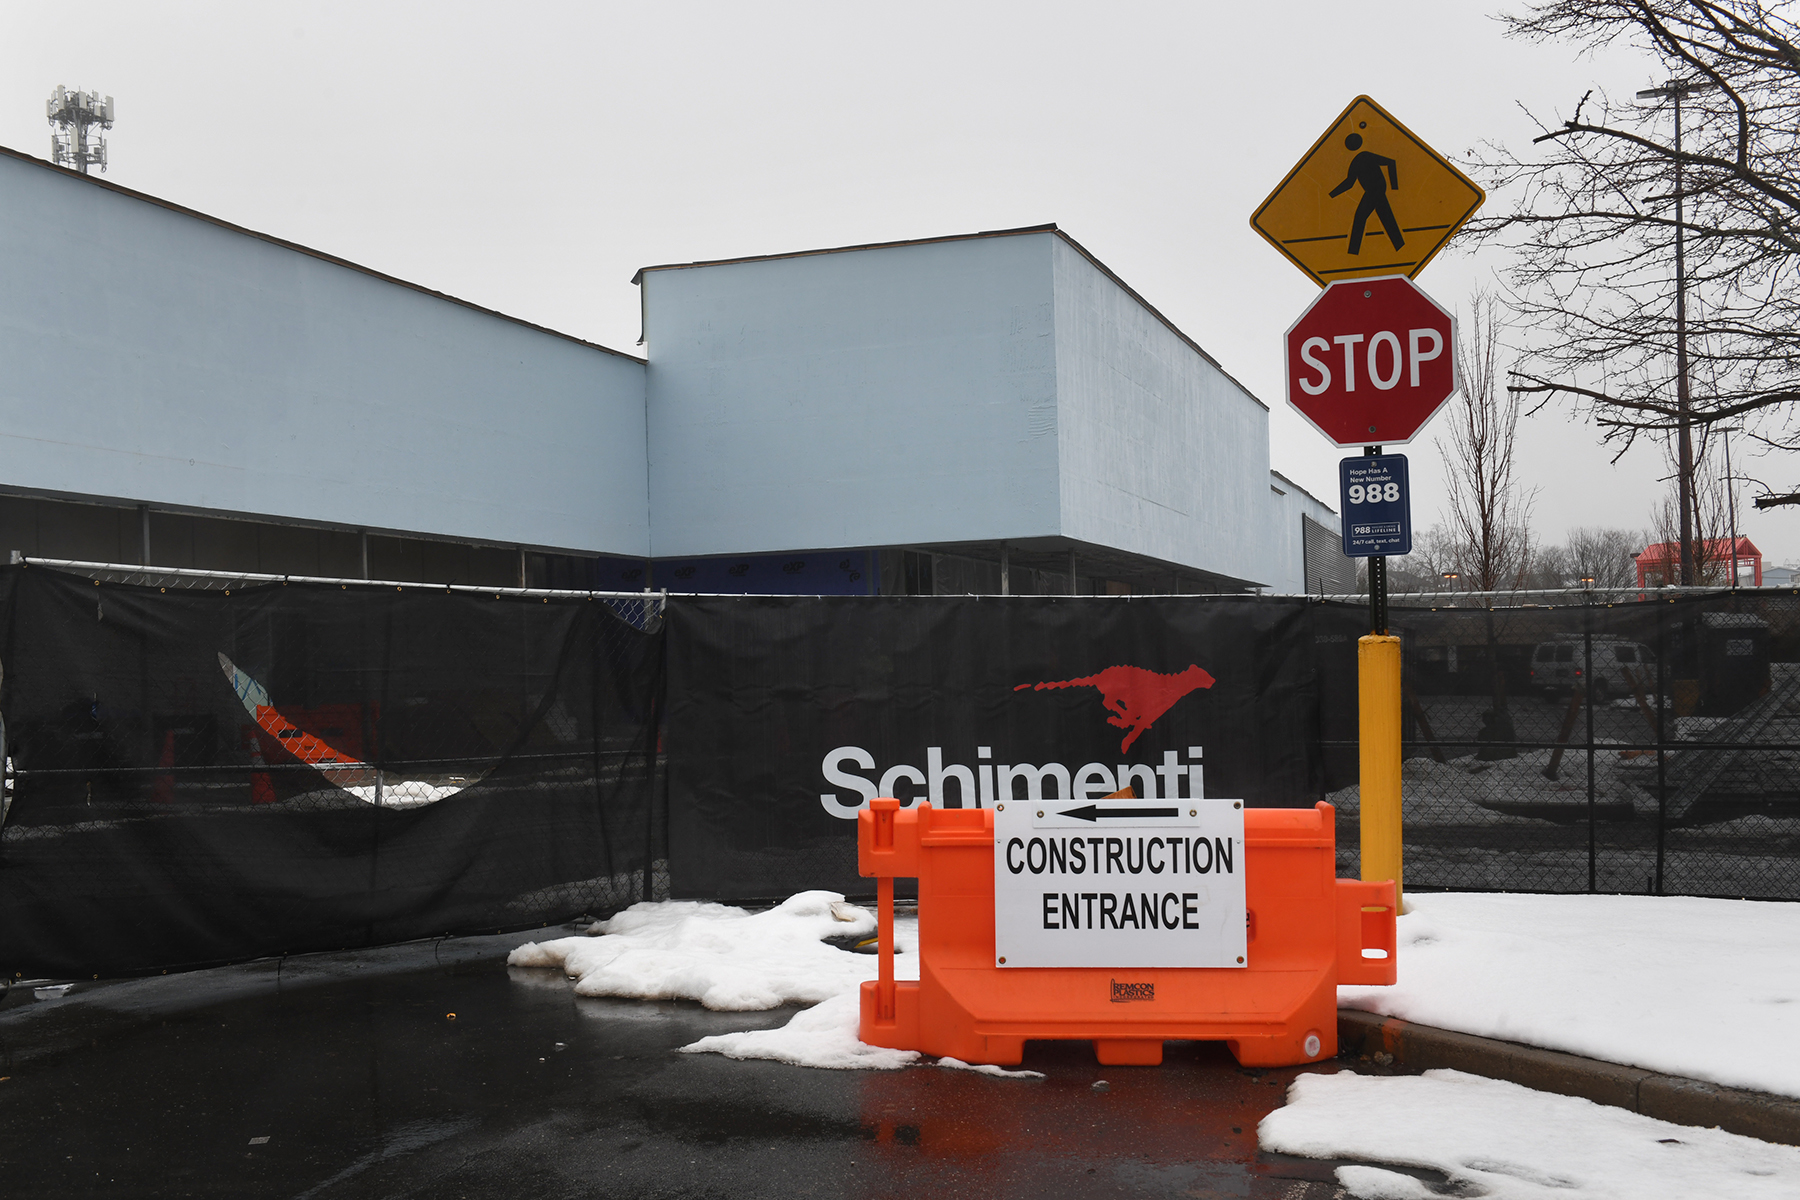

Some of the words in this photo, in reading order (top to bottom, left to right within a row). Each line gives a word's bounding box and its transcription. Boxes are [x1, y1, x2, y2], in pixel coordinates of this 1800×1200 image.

[1299, 328, 1443, 396] STOP
[1348, 482, 1400, 505] 988
[1354, 526, 1371, 534] 988
[820, 746, 1204, 820] Schimenti
[1006, 837, 1234, 875] CONSTRUCTION
[1043, 892, 1200, 931] ENTRANCE
